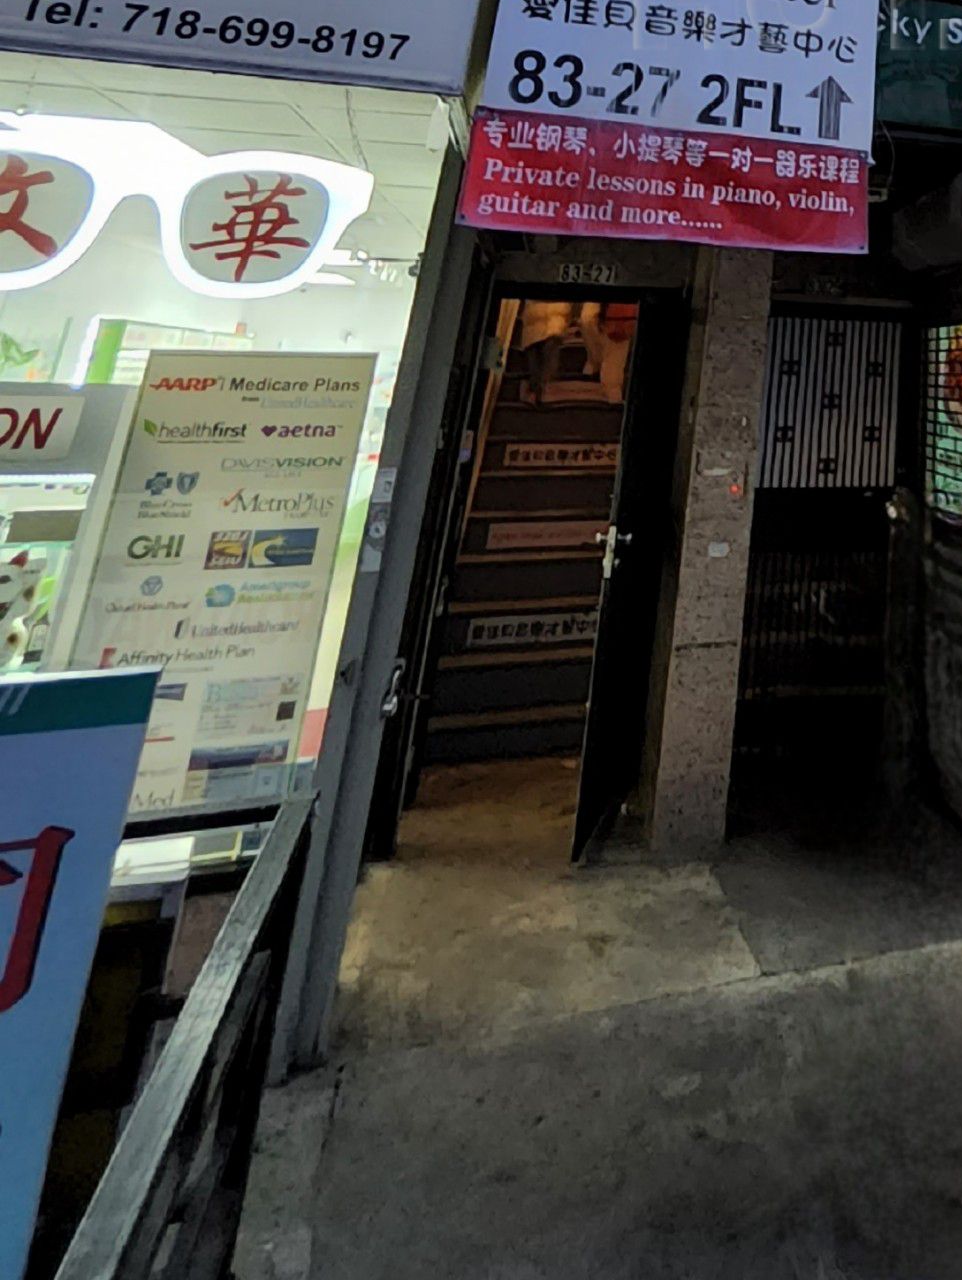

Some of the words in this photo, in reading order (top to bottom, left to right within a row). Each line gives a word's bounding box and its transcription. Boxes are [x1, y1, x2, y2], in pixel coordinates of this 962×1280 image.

[121, 2, 410, 62] 718-699-8197
[508, 49, 682, 119] 83-27
[696, 73, 803, 137] 2FL
[483, 157, 580, 190] Private
[588, 166, 676, 198] lessons
[682, 174, 706, 200] in
[710, 178, 782, 212] piano,
[788, 186, 856, 217] violin,
[477, 191, 556, 220] guitar
[565, 196, 612, 222] and
[189, 172, 312, 283] 華
[561, 264, 614, 283] 83-27
[149, 377, 217, 392] AARP
[229, 377, 309, 393] Medicare
[313, 377, 360, 393] Plans
[158, 421, 248, 439] healthfirst
[278, 423, 337, 439] aetna
[127, 534, 186, 560] GHI
[175, 646, 222, 662] Health
[225, 644, 256, 659] Plan
